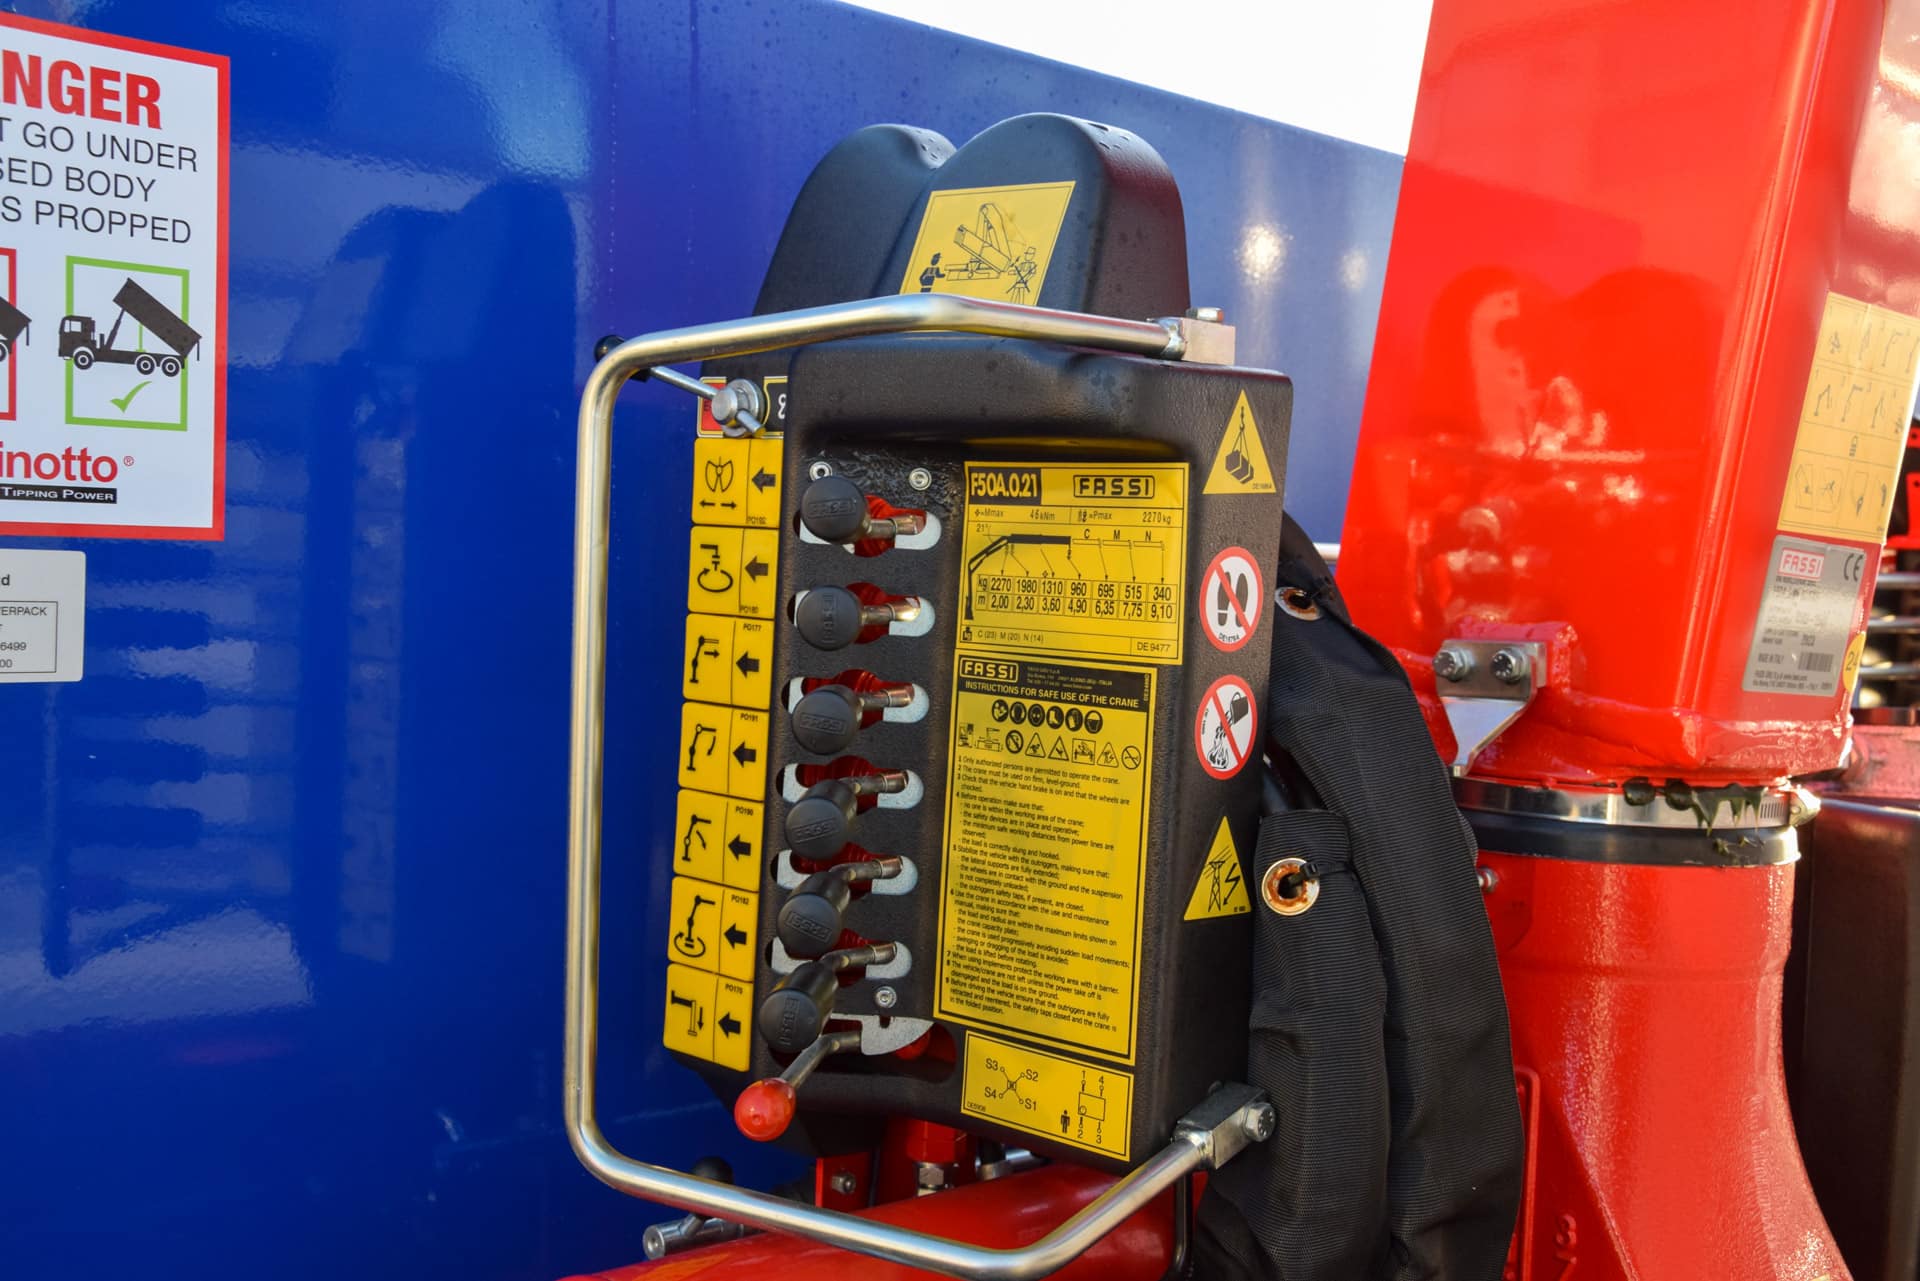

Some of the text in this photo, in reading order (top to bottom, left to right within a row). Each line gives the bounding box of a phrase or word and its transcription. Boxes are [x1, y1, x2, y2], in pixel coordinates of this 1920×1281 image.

[0, 49, 162, 130] NGER
[23, 121, 74, 152] GO
[87, 131, 198, 172] UNDER
[0, 156, 156, 202] ED BODY
[1, 196, 191, 244] S PROPPED
[62, 489, 114, 501] POWER
[970, 472, 1150, 498] F50A.0.21 FASSI
[1084, 529, 1151, 541] C M N
[1782, 553, 1822, 576] FASSI
[991, 577, 1011, 592] 2270
[1017, 578, 1037, 593] 1980
[1042, 580, 1063, 595] 1310
[1071, 582, 1087, 597] 960
[1098, 583, 1114, 598] 695
[1125, 584, 1142, 600] 515
[1153, 586, 1172, 601] 340
[991, 594, 1009, 610] 2,00
[1016, 596, 1034, 612] 2,30
[1042, 597, 1061, 614] 3,60
[1068, 598, 1087, 615] 4,90
[1095, 600, 1114, 616] 6,35
[1123, 601, 1143, 620] 7,75
[1151, 604, 1173, 621] 9,10
[964, 661, 1014, 679] FASSI
[966, 680, 1019, 695] INSTRUCTIONS
[1020, 687, 1037, 697] FOR
[1038, 689, 1060, 700] SAFE
[1061, 691, 1077, 701] USE
[1078, 693, 1091, 703] OF
[1092, 695, 1107, 705] THE
[1109, 697, 1139, 708] CRANE
[985, 1057, 998, 1071] S3
[1026, 1069, 1039, 1082] S2
[1098, 1075, 1104, 1085] 4
[984, 1087, 997, 1099] S4
[1024, 1097, 1037, 1111] S1
[1077, 1129, 1102, 1144] 2 3
